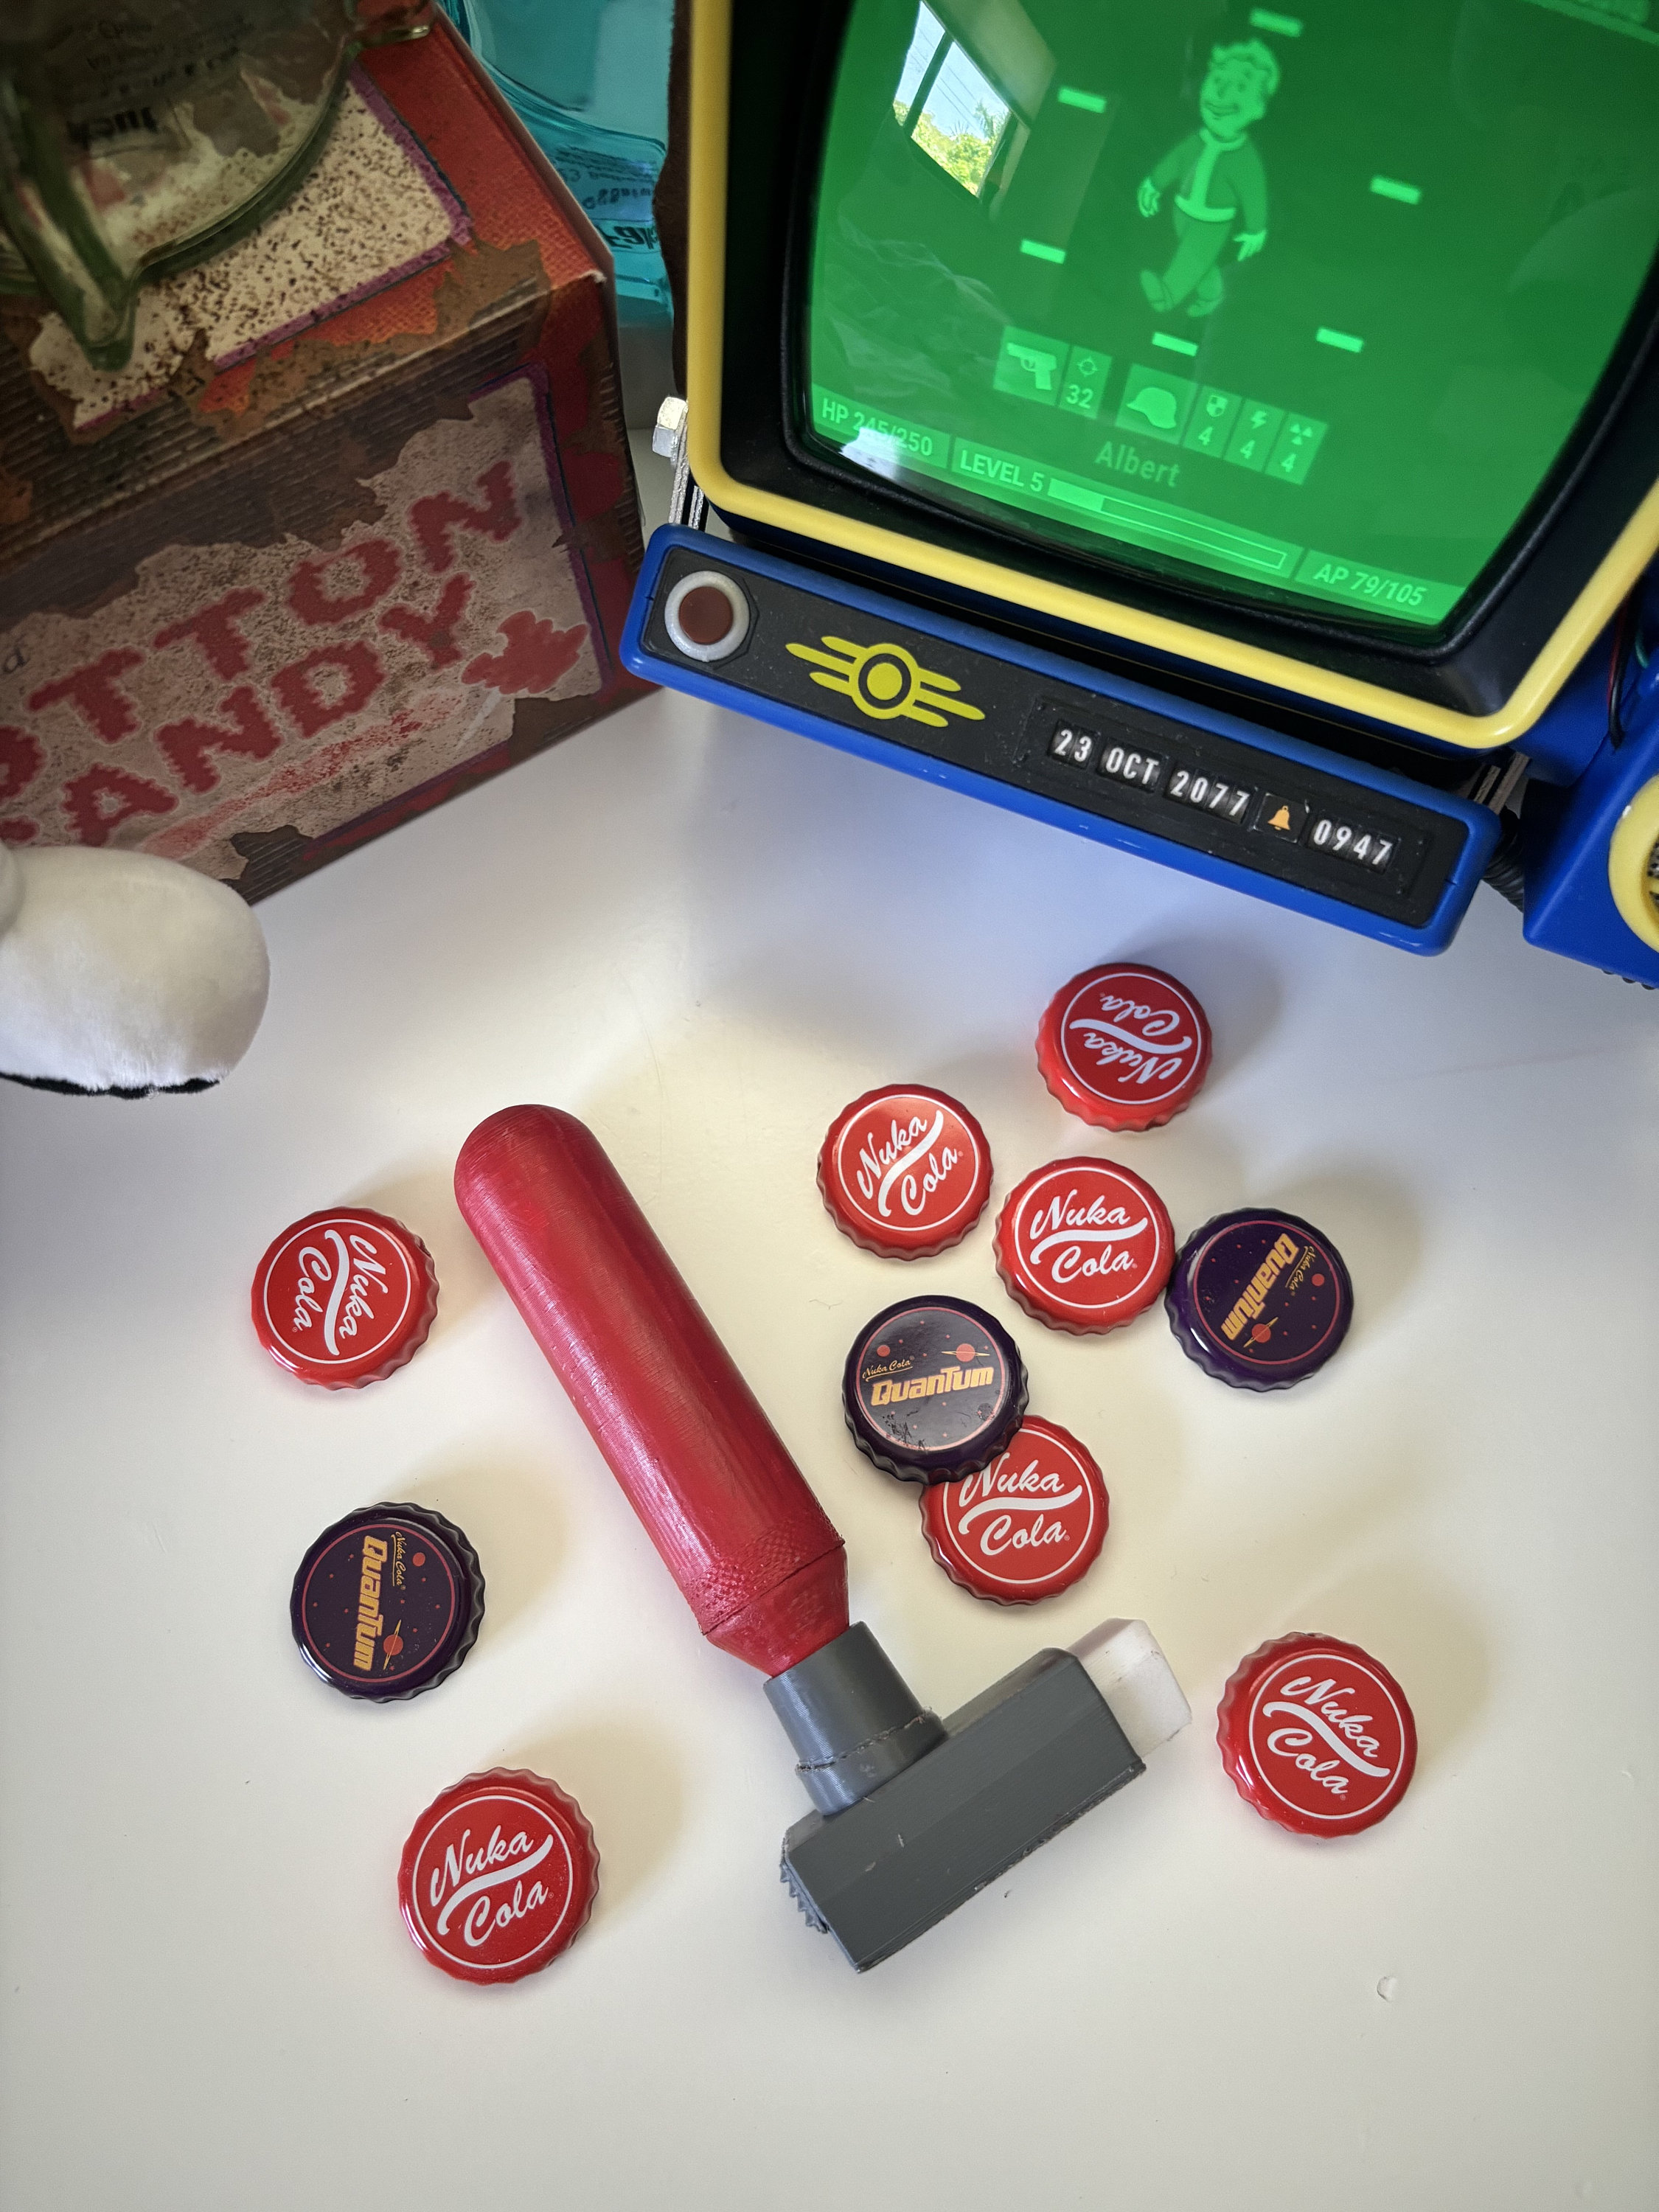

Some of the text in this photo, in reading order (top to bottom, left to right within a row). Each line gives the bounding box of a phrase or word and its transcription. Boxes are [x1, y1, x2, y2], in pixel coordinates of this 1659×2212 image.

[821, 397, 849, 424] HP
[1065, 384, 1094, 409] 32
[1197, 426, 1214, 446] 4
[1239, 439, 1256, 459] 4
[960, 449, 1046, 493] LEVEL 5
[1094, 440, 1180, 488] Albert
[1281, 453, 1297, 473] 4
[1312, 563, 1428, 606] AP 79/105
[0, 571, 476, 849] ANDY
[1054, 728, 1394, 866] 23 OCT 2077 0947
[1099, 995, 1180, 1037] Cola
[1083, 1032, 1183, 1084] Nuka
[856, 1116, 928, 1200] Nuka
[900, 1146, 958, 1216] Cola
[1029, 1189, 1131, 1240] Nuka
[294, 1246, 333, 1332] Cola
[338, 1234, 389, 1339] Nuka
[1051, 1244, 1134, 1284] Cola
[1290, 1246, 1315, 1290] Nuka Cola
[862, 1359, 911, 1380] Nuka Cola
[959, 1452, 1065, 1507] Nuka
[395, 1531, 407, 1586] Nuka Cola
[980, 1513, 1067, 1556] Cola
[1279, 1676, 1380, 1758] Nuka
[1267, 1727, 1349, 1795] Cola
[430, 1824, 534, 1907] Nuka
[464, 1879, 549, 1947] Cola
